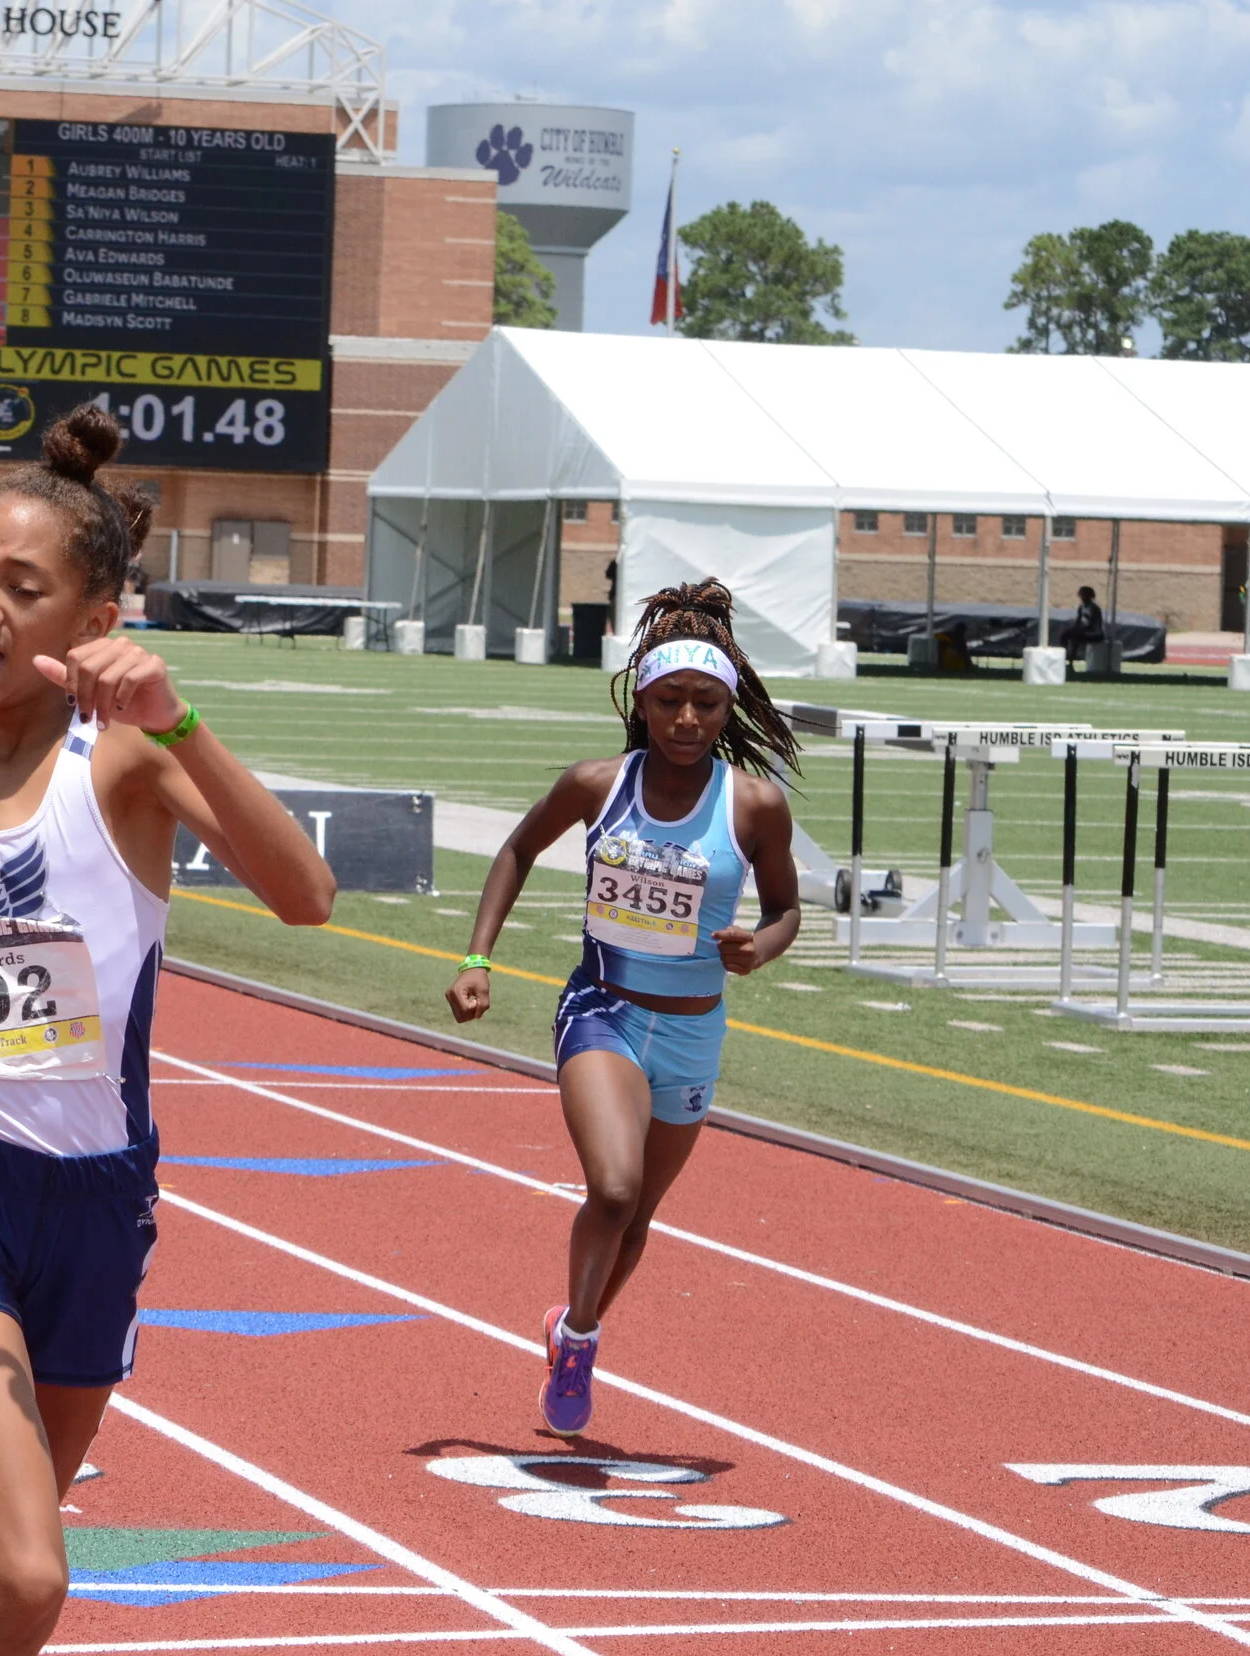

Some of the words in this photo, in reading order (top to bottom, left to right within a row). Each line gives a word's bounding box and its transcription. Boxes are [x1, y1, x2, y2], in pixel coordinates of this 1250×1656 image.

[2, 7, 121, 38] HOUSE
[58, 123, 108, 141] GIRLS
[113, 125, 153, 144] 400M
[169, 129, 186, 146] 10
[190, 130, 246, 149] YEARS
[251, 132, 285, 151] OLD
[540, 127, 570, 151] CITY
[572, 129, 587, 153] OF
[140, 149, 176, 162] START
[179, 150, 201, 163] LIST
[27, 160, 34, 173] 1
[67, 161, 120, 178] AUBREY
[126, 165, 190, 182] WILLIAMS
[26, 181, 34, 194] 2
[67, 182, 125, 200] MEAGAN
[129, 186, 185, 202] BRIDGES
[26, 202, 34, 216] 3
[125, 207, 178, 223] WILSON
[24, 224, 32, 237] 4
[65, 226, 154, 243] CARRINGTON
[158, 230, 206, 246] HARRIS
[23, 245, 31, 258] 5
[65, 247, 94, 262] AVA
[98, 249, 164, 265] EDWARDS
[22, 266, 31, 280] 6
[63, 268, 149, 285] OLUWASEUN
[153, 272, 233, 289] BABATUNDE
[22, 288, 30, 301] 7
[131, 294, 196, 310] MITCHELL
[21, 309, 29, 323] 8
[62, 311, 122, 328] MADISYN
[126, 315, 172, 330] SCOTT
[151, 355, 298, 385] GAMES
[979, 732, 1035, 745] HUMBLE
[1165, 751, 1227, 767] HUMBLE
[630, 874, 665, 887] Wilson
[597, 876, 693, 919] 3455
